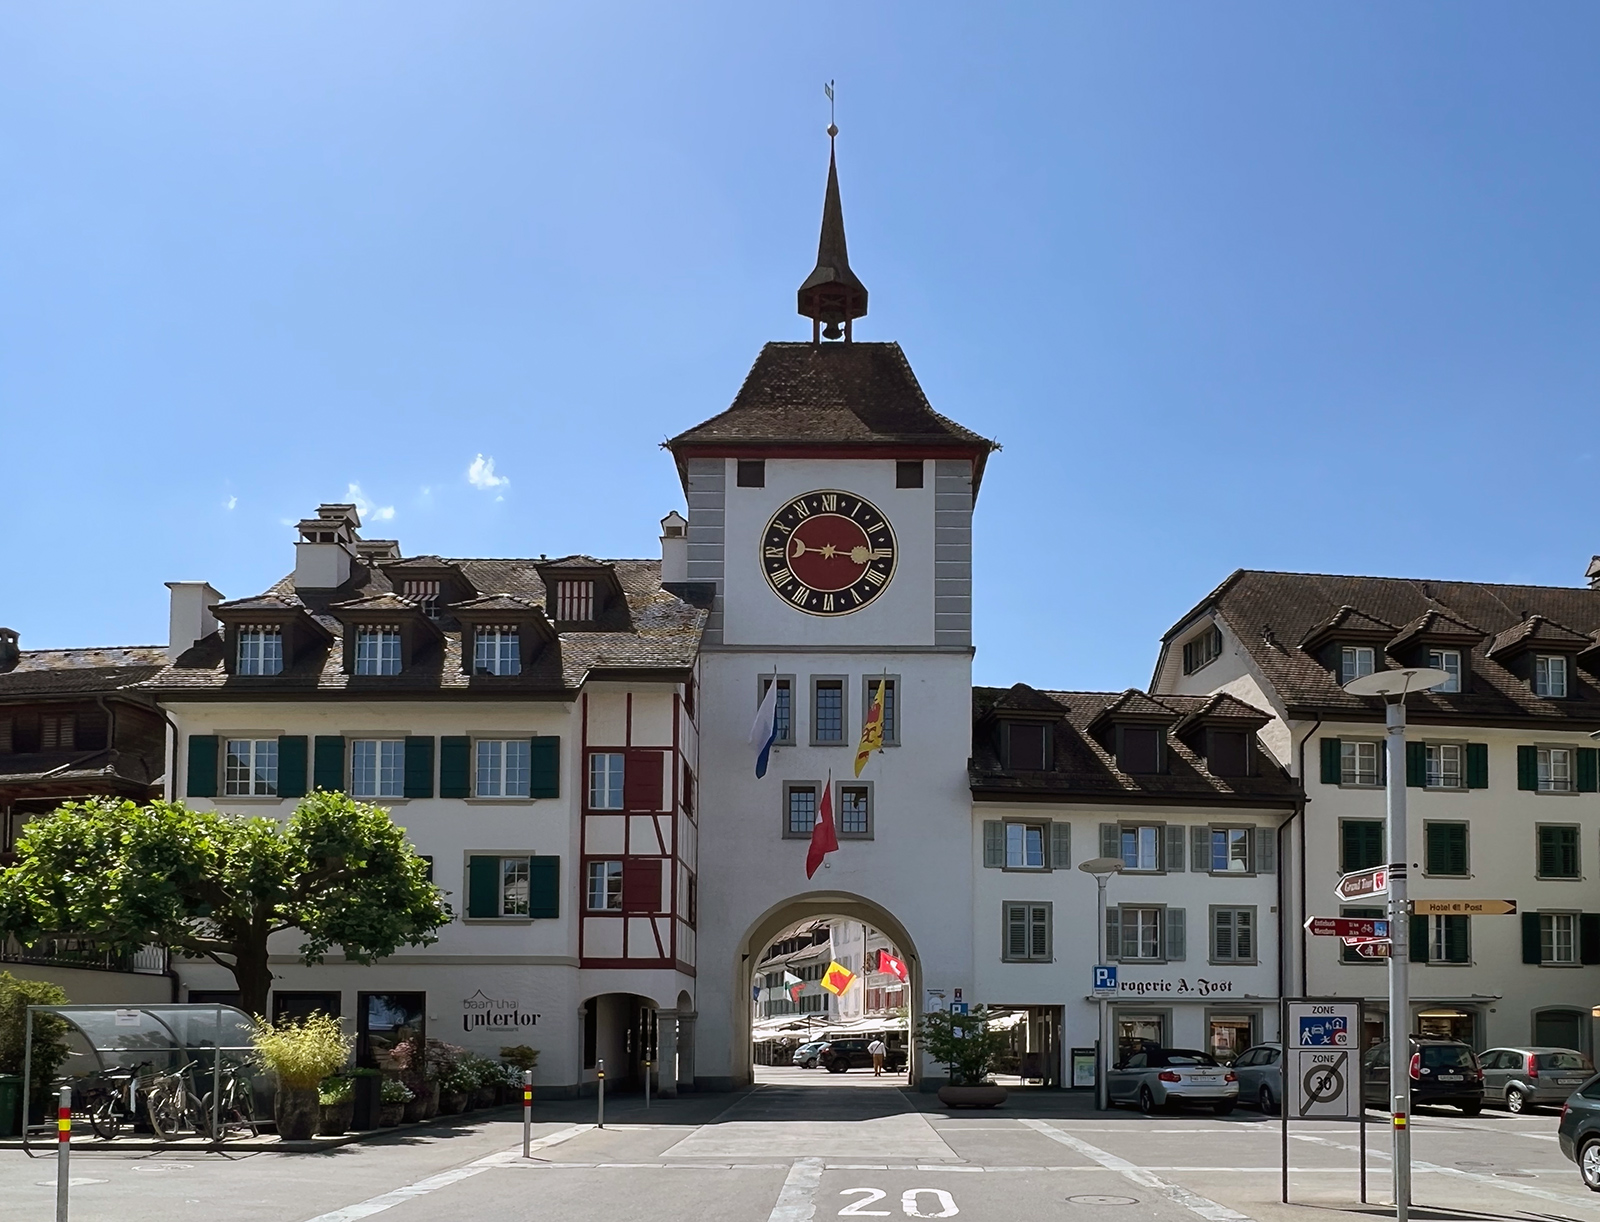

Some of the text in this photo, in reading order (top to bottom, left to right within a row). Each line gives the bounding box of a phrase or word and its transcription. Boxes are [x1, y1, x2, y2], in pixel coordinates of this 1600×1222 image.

[822, 494, 837, 512] XII
[1344, 879, 1361, 892] Grand
[1429, 903, 1482, 911] Hotel Post
[1096, 968, 1108, 985] P
[1118, 979, 1172, 995] rogerie
[1177, 978, 1195, 994] A.
[1198, 978, 1233, 996] Jost
[463, 999, 519, 1010] baan thai
[1312, 1006, 1335, 1014] ZONE
[463, 1009, 541, 1032] Untertor
[1337, 1034, 1347, 1043] 20
[1312, 1055, 1335, 1063] ZONE
[1316, 1076, 1332, 1091] 30
[838, 1187, 960, 1218] 20
